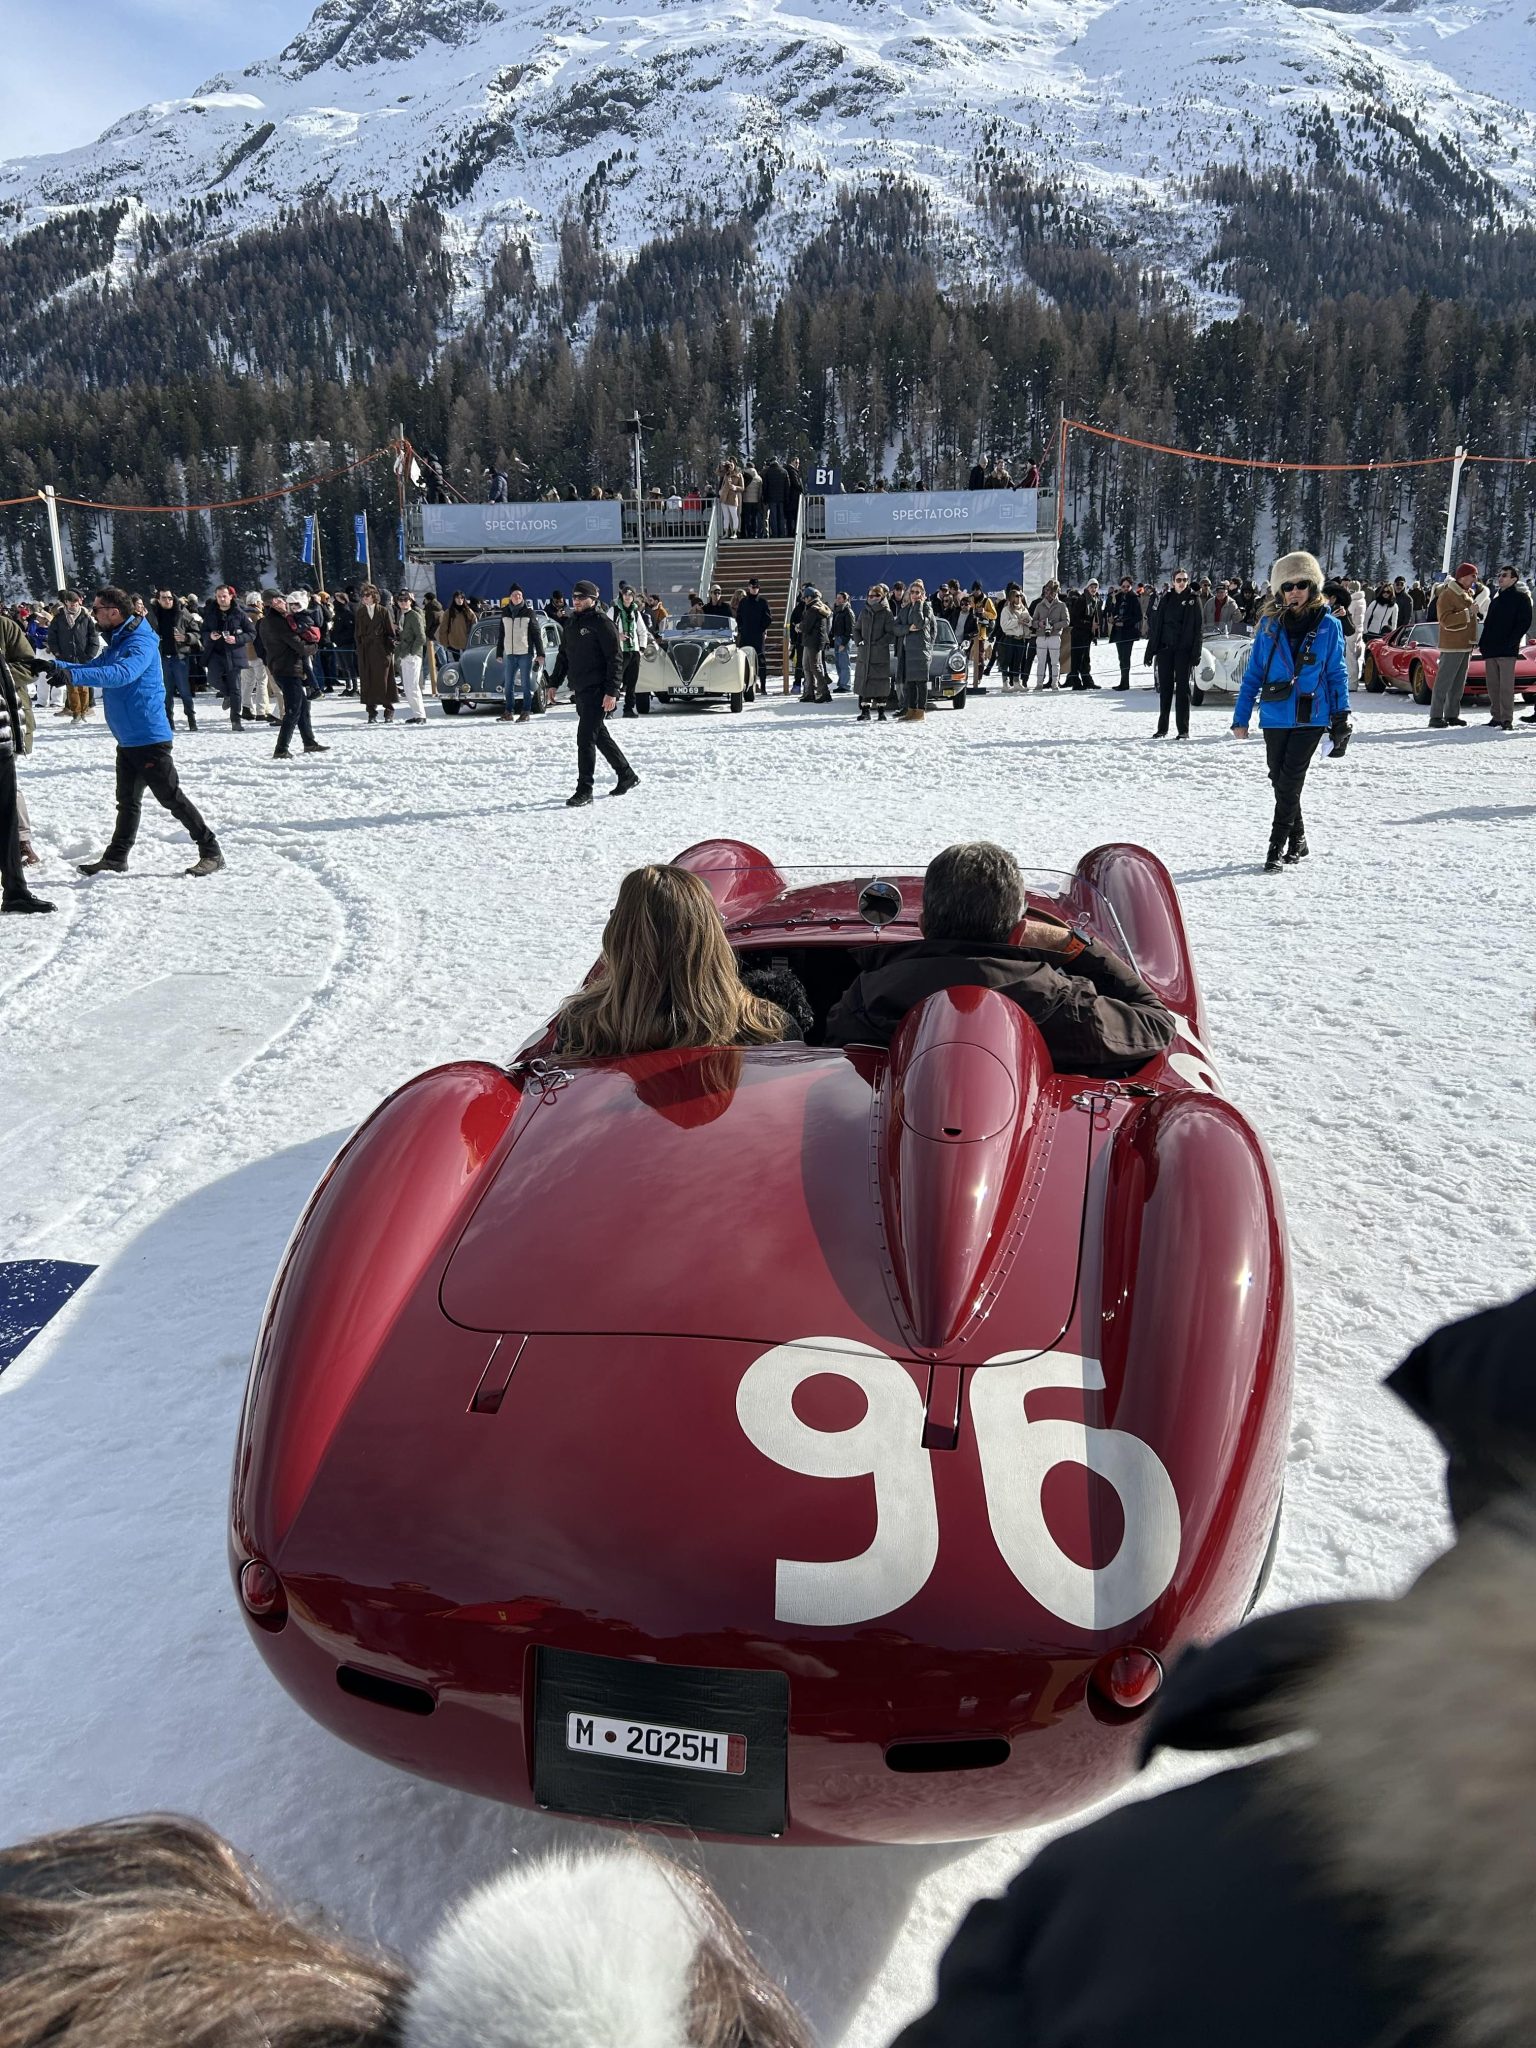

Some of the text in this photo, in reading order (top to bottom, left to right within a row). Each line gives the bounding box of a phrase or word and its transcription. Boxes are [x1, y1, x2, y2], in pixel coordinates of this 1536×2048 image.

[815, 469, 834, 485] B1
[892, 507, 969, 521] SPECTATORS
[485, 519, 558, 531] SPECTATORS
[736, 1336, 1182, 1630] 96
[576, 1718, 594, 1746] M
[626, 1726, 719, 1764] 2025H
